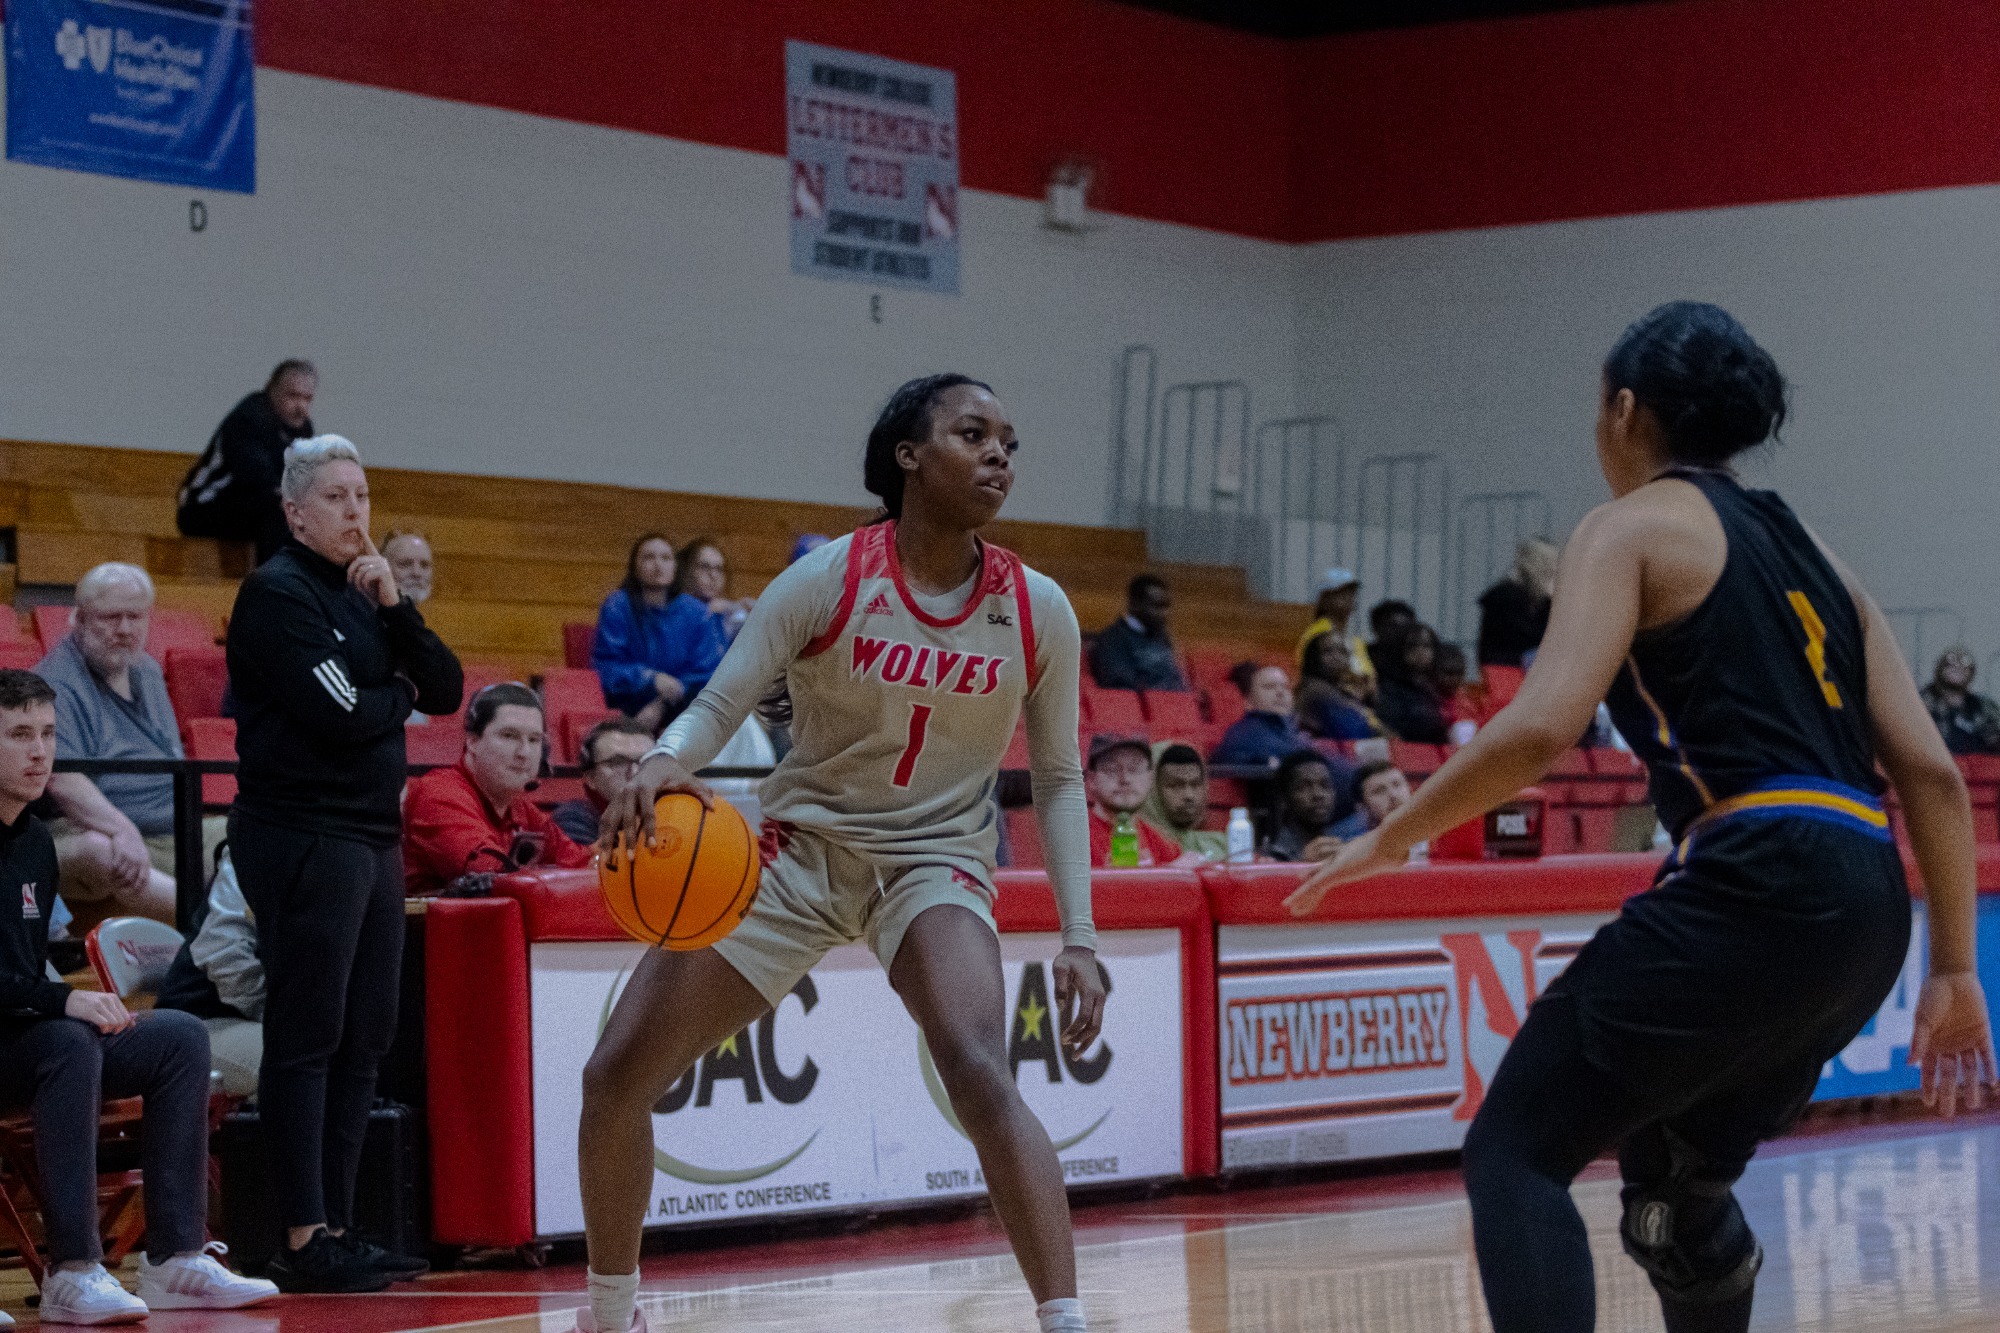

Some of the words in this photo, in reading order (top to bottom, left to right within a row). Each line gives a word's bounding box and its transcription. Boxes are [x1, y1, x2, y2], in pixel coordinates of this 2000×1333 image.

[846, 155, 904, 200] CLUB
[189, 200, 208, 232] D
[987, 613, 1013, 627] SAC
[851, 634, 1009, 697] WOLVES
[890, 702, 935, 789] 1
[652, 973, 820, 1114] AC
[1228, 985, 1449, 1087] NEWBERRY
[925, 1169, 969, 1190] SOUTH
[1062, 1156, 1119, 1178] FERENCE
[658, 1192, 729, 1217] ATLANTIC
[735, 1182, 832, 1209] CONFERENCE
